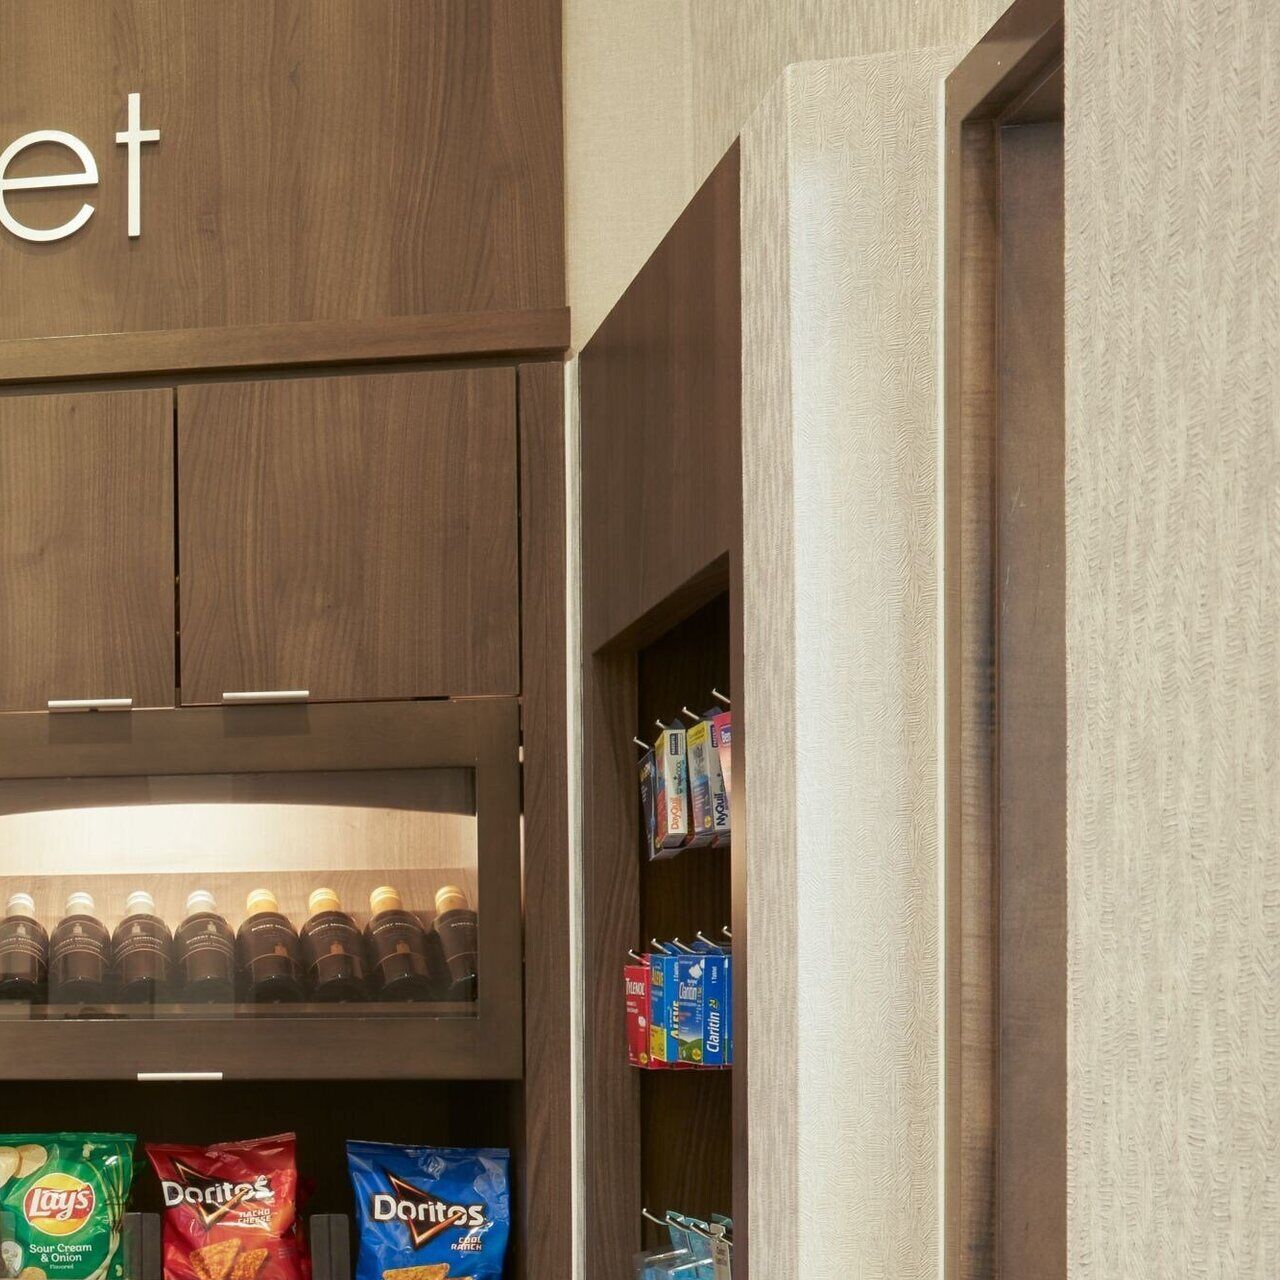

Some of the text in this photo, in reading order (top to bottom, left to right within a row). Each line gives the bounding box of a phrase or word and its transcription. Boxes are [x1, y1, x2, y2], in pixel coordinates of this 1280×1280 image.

[714, 792, 728, 826] NyQuil
[706, 1011, 721, 1053] Claritin
[161, 1175, 276, 1207] Doritos
[28, 1184, 92, 1221] Lay's
[239, 1208, 272, 1218] NACHO
[373, 1194, 486, 1228] Doritos
[29, 1243, 92, 1254] Sour Cream
[451, 1243, 483, 1252] RANCH
[458, 1236, 482, 1245] COOL
[40, 1253, 83, 1263] & Onion
